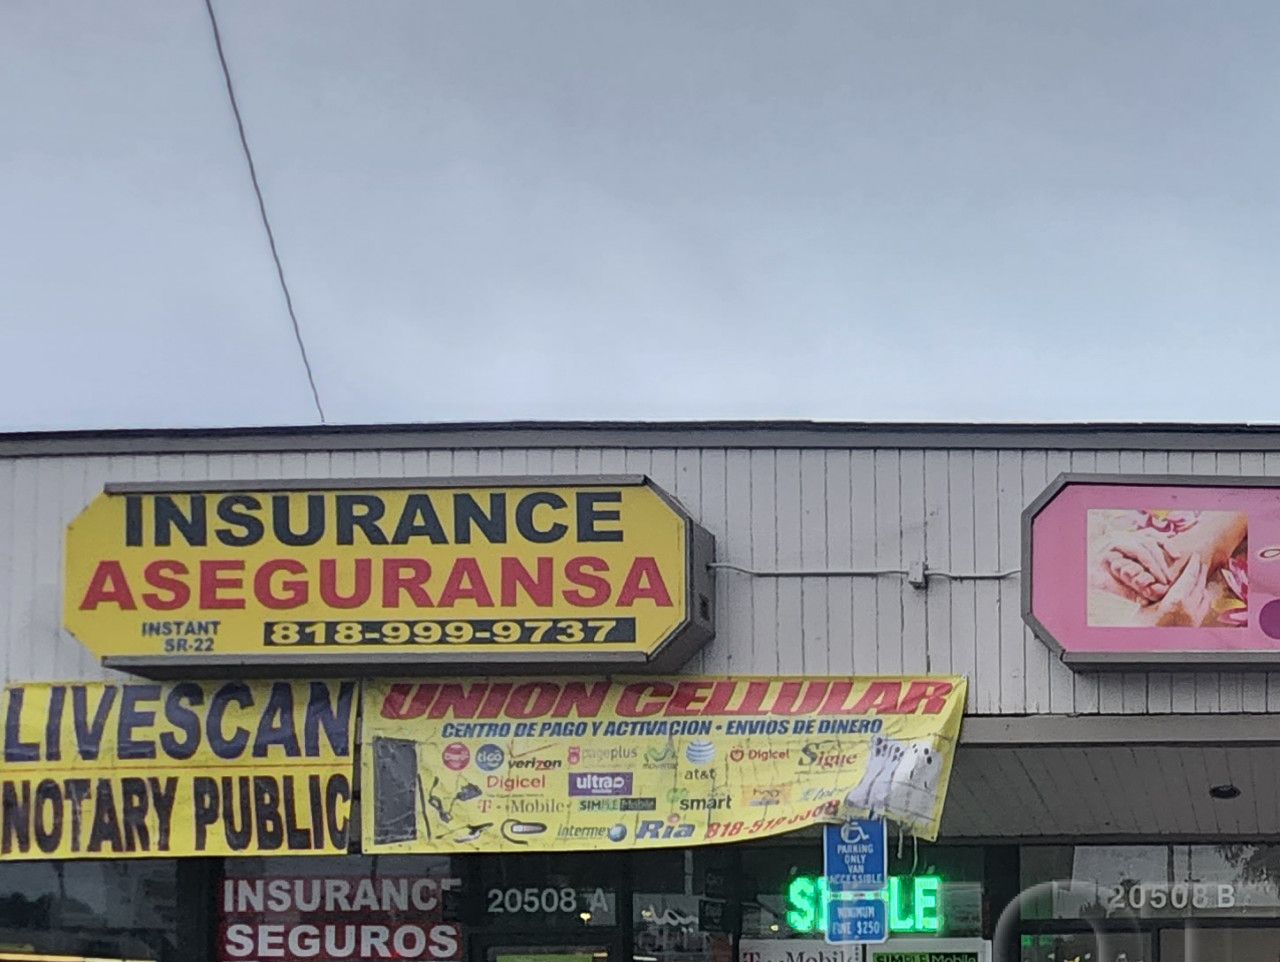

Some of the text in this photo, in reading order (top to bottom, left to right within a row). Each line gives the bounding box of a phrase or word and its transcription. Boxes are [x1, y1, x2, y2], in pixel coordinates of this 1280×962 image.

[125, 491, 625, 547] INSURANCE
[79, 557, 674, 611] ASEGURANSA
[142, 620, 220, 637] INSTANT
[271, 620, 616, 645] 818-999-9737
[164, 638, 215, 653] SR-22
[380, 679, 952, 719] UNION CELLULAR
[4, 680, 355, 762] LIVESCAN
[441, 718, 883, 738] CENTRO DE PAGO Y ACTIVACION ENVIOS DE DINERO
[508, 757, 562, 770] verizon
[748, 749, 790, 761] Digicel
[797, 742, 858, 769] Sigue
[486, 774, 547, 791] Digicel
[684, 767, 717, 781] at&t
[679, 793, 733, 809] smart
[0, 773, 350, 855] NOTARY PUBLIC
[635, 812, 697, 840] Ria
[837, 844, 874, 855] PARKING
[844, 854, 867, 865] ONLY
[829, 873, 883, 885] ACCESSIBLE
[847, 864, 865, 874] VAN
[224, 877, 462, 913] INSURANC
[487, 887, 610, 913] 20508 A
[1108, 883, 1237, 909] 20508 B
[856, 920, 880, 935] $250
[225, 923, 458, 958] SEGUROS
